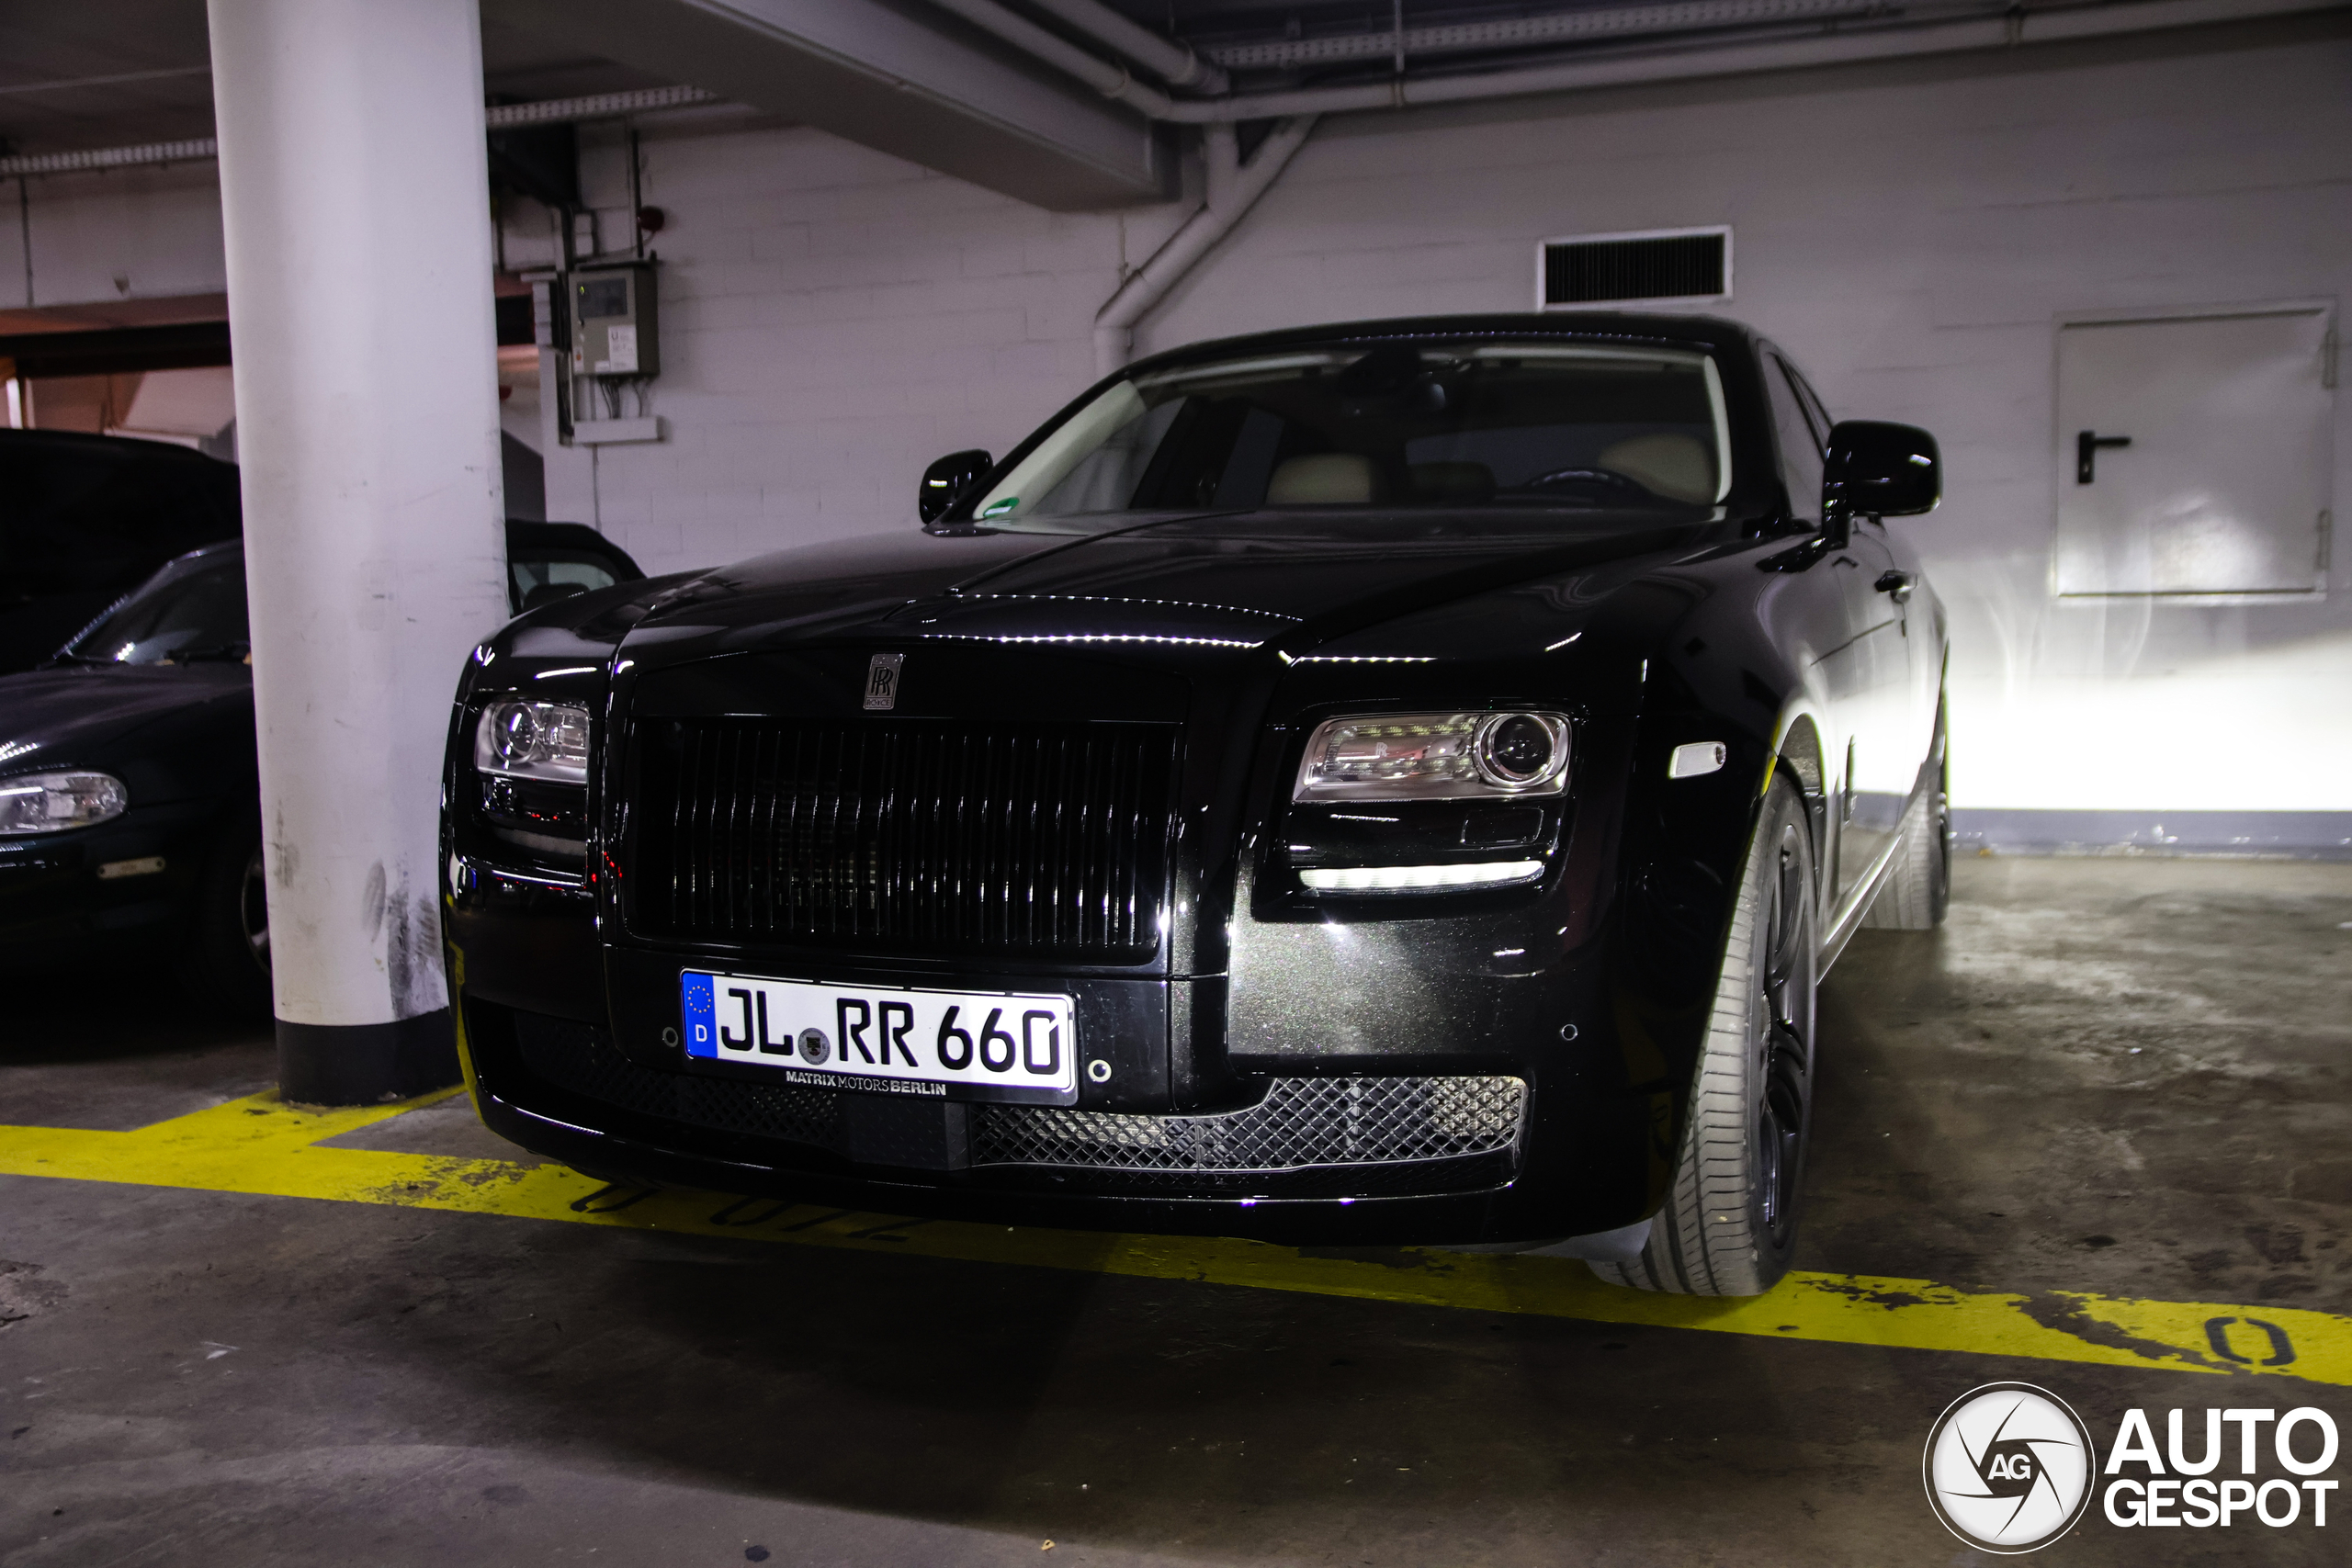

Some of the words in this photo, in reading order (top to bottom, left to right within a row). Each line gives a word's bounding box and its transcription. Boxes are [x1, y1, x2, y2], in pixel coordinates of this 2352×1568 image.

[695, 1024, 707, 1043] D
[721, 987, 794, 1057] JL
[837, 997, 920, 1067] RR
[936, 1005, 1060, 1076] 660
[786, 1070, 837, 1087] MATRIX
[837, 1075, 889, 1092] MOTORS
[889, 1080, 947, 1096] BERLIN
